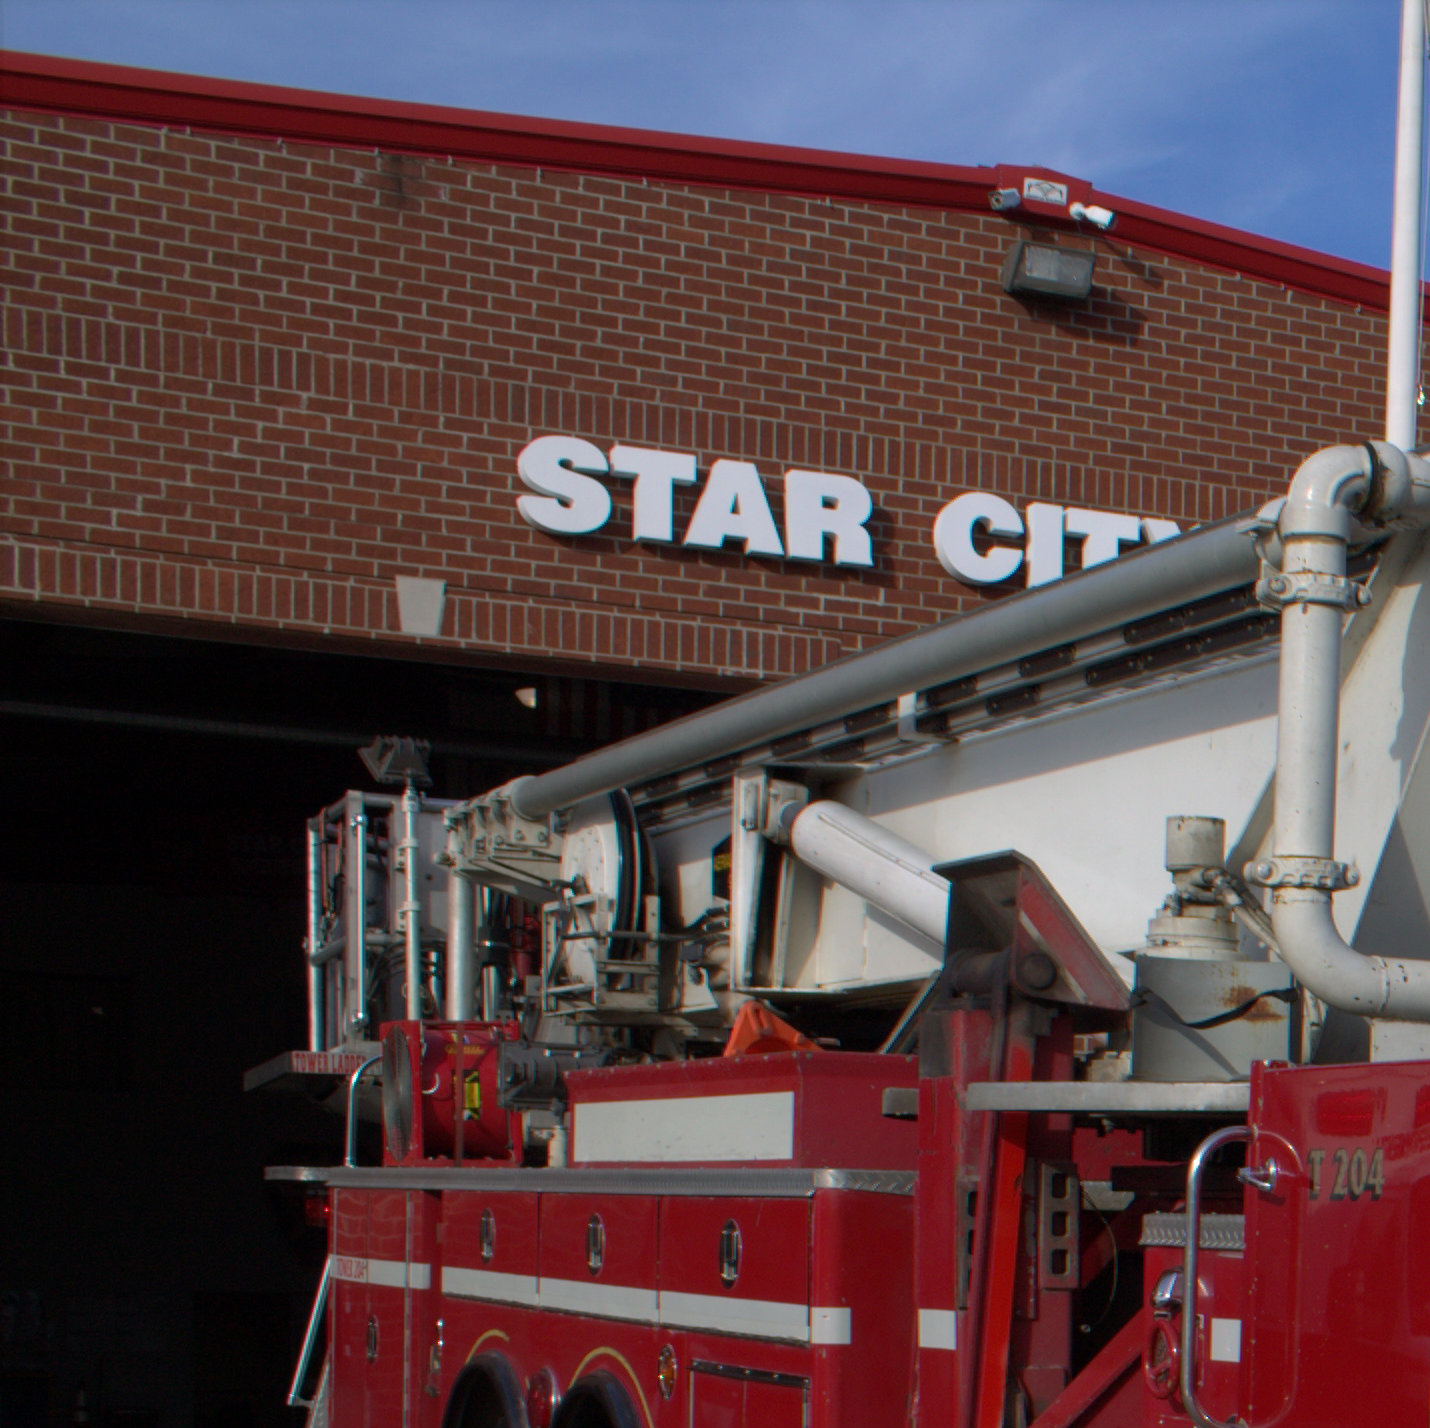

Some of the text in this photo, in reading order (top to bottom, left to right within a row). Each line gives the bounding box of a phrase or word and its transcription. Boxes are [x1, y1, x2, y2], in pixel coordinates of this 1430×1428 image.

[516, 435, 1202, 590] STAR CIT
[1308, 1147, 1385, 1200] T 204
